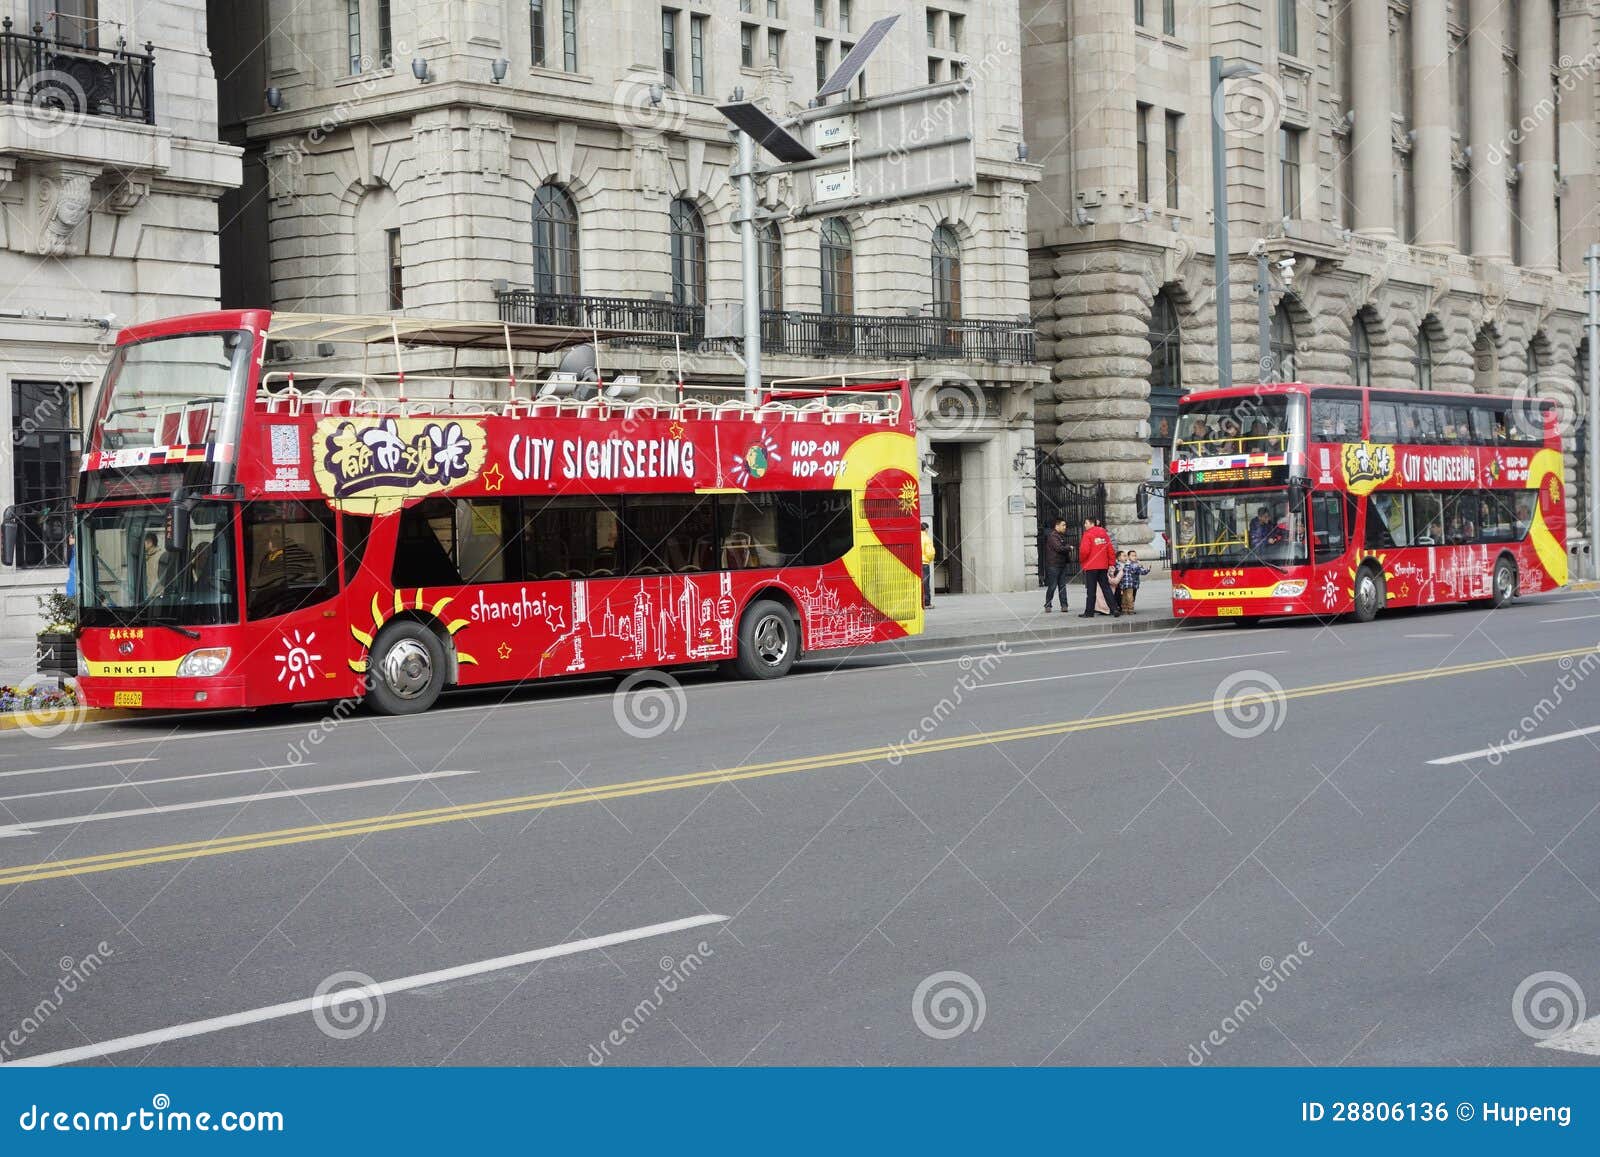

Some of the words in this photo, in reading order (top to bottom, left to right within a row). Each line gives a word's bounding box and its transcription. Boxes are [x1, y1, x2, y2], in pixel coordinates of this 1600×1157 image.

[328, 418, 470, 478] 都市观光
[509, 434, 554, 480] CITY
[563, 435, 695, 480] SIGHTSEEING
[791, 440, 840, 457] HOP-ON
[792, 460, 848, 477] HOP-OFF
[1402, 452, 1421, 482] CITY
[1423, 454, 1475, 482] SIGHTSEEING
[471, 587, 547, 627] shanghai
[103, 666, 155, 674] ANKAI
